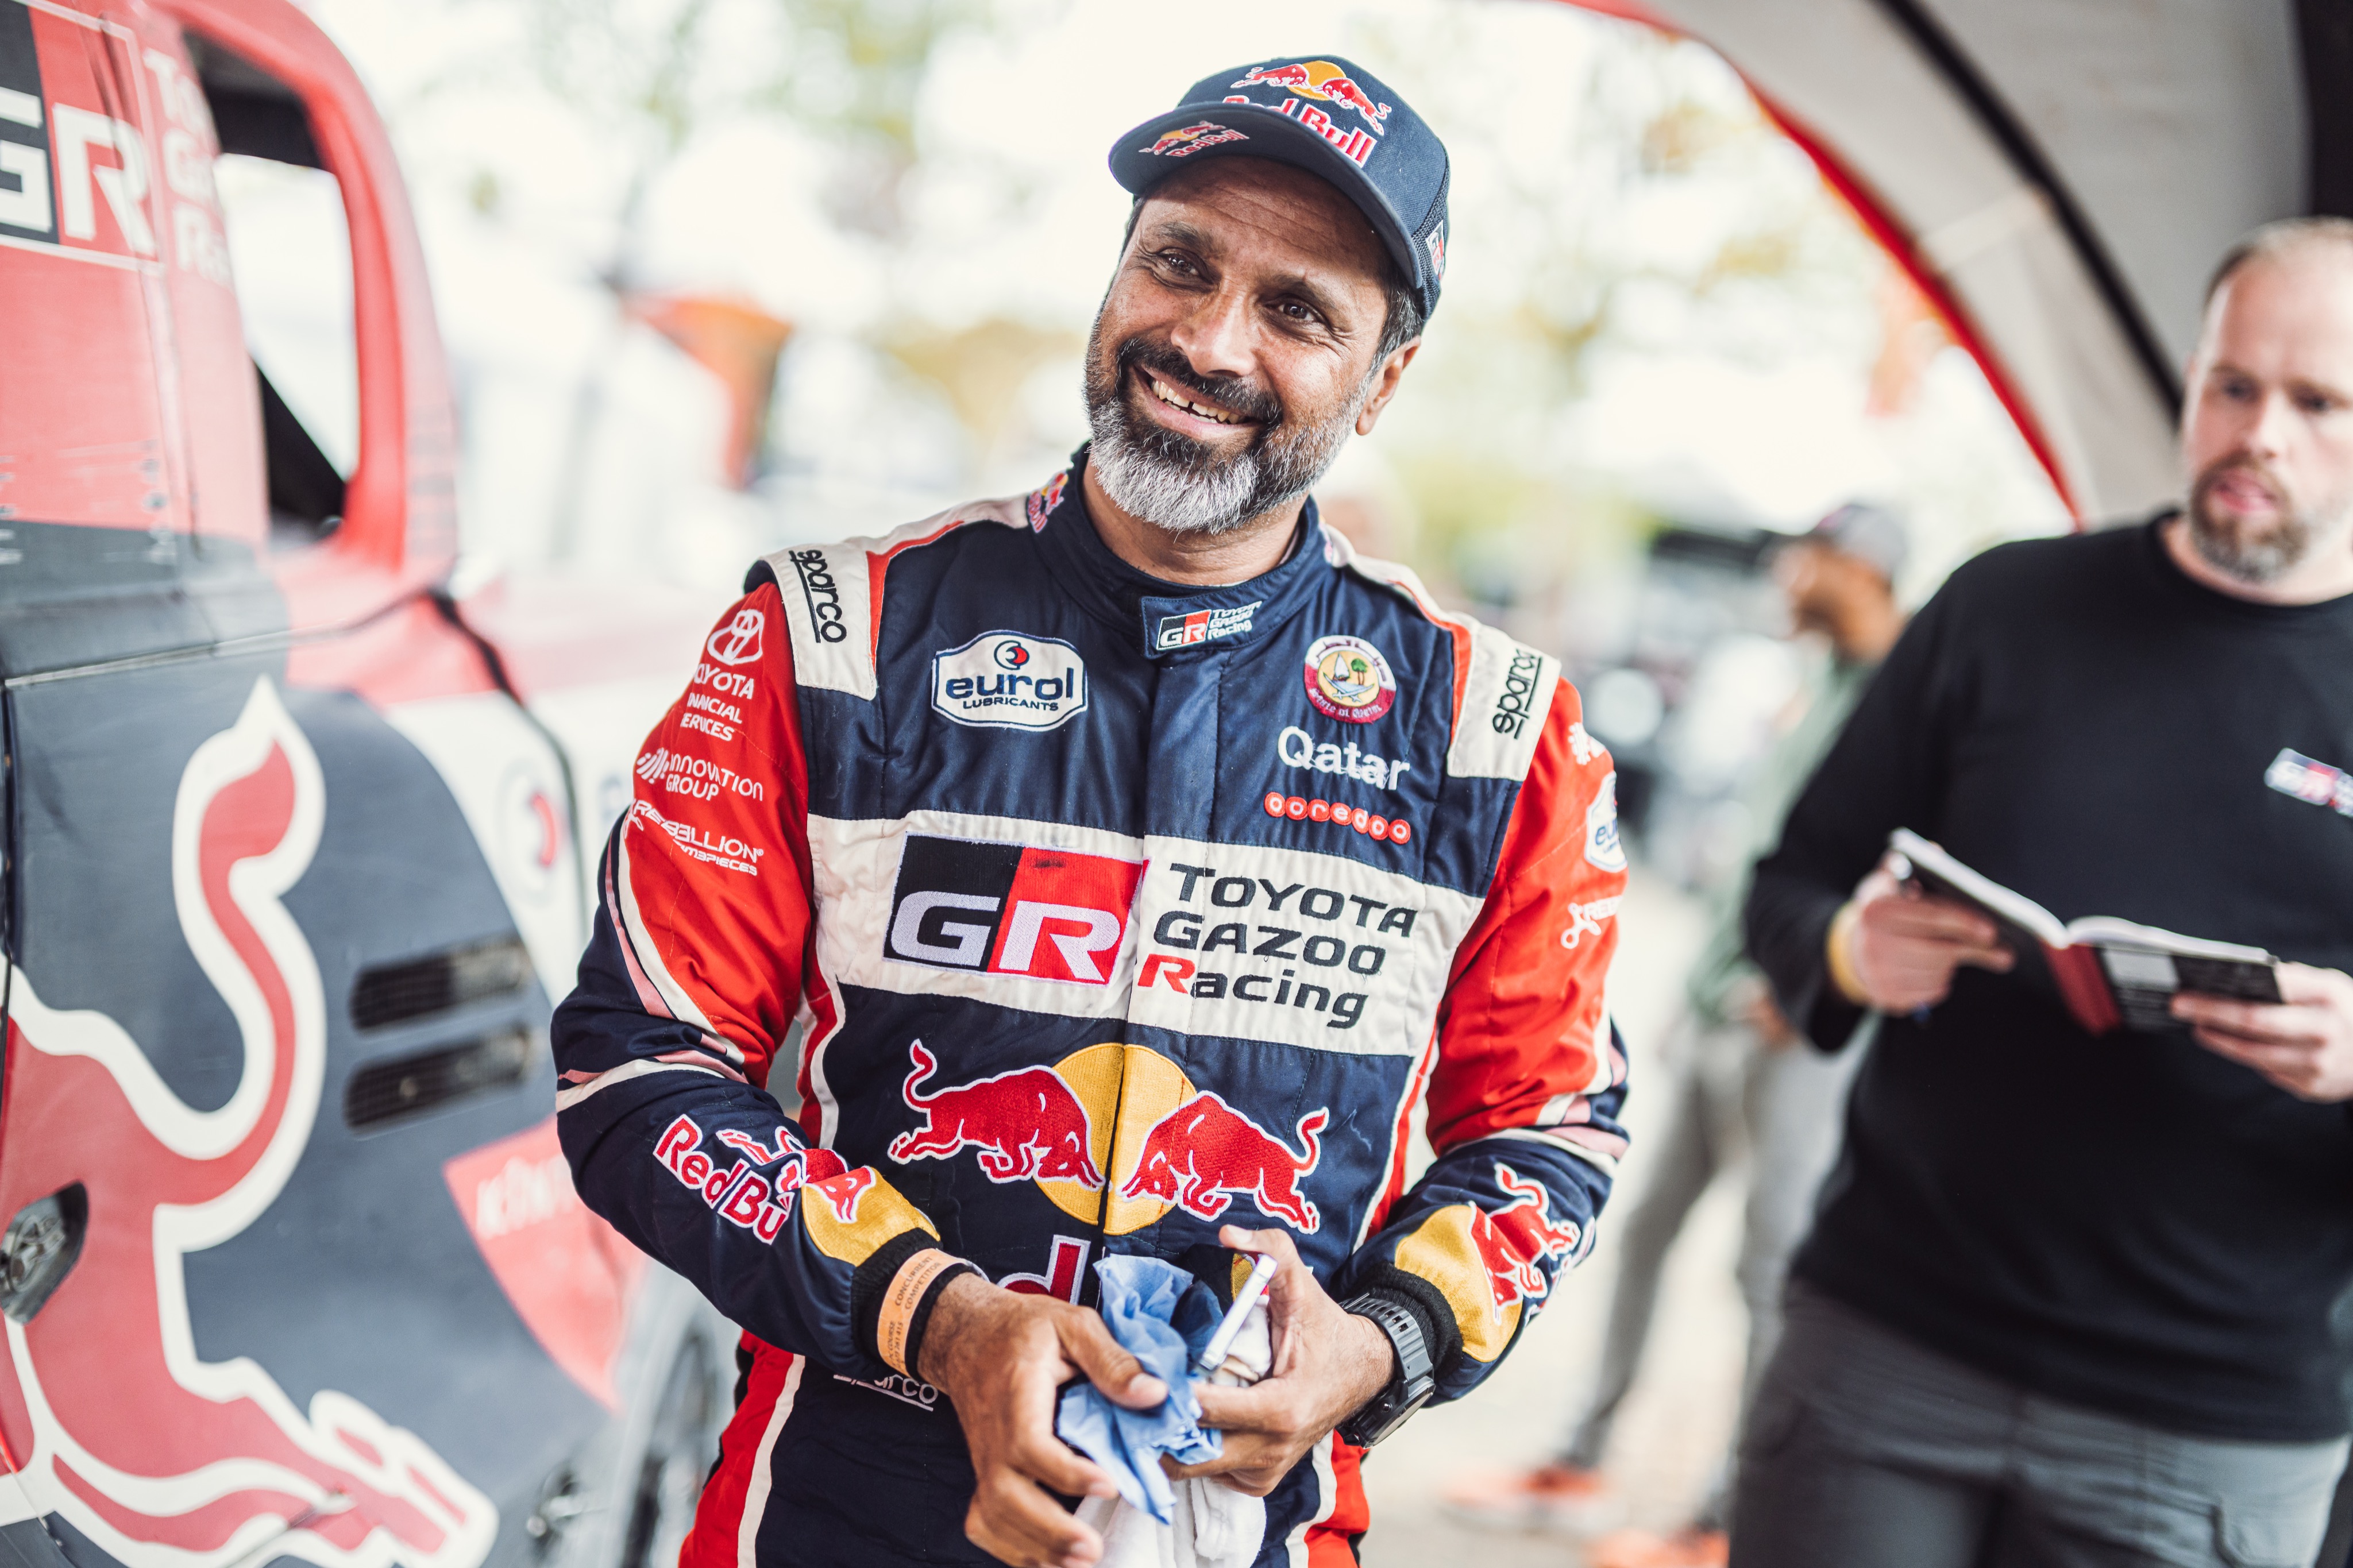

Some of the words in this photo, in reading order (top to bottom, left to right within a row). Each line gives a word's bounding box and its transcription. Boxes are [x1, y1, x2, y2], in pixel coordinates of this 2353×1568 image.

[1165, 138, 1215, 157] Red
[1201, 129, 1249, 144] Bull
[790, 550, 847, 643] sparco
[1209, 609, 1253, 629] GAZOO
[1159, 623, 1207, 647] GR
[1208, 619, 1252, 640] Racing
[694, 663, 754, 700] OYOTA
[945, 667, 1074, 700] eurol
[962, 698, 1059, 712] LUBRICANTS
[1278, 725, 1410, 791] Qatar
[666, 773, 719, 801] GROUP
[1267, 794, 1409, 841] ooredoo
[1169, 863, 1418, 938] TOYOTA
[890, 890, 1122, 985] GR
[1152, 912, 1386, 976] GAZOO
[1137, 952, 1369, 1029] Racing
[653, 1114, 749, 1210] Red
[718, 1170, 794, 1246] Bu
[895, 1256, 933, 1307] CONCURRENT
[904, 1261, 942, 1310] COMPETITOR
